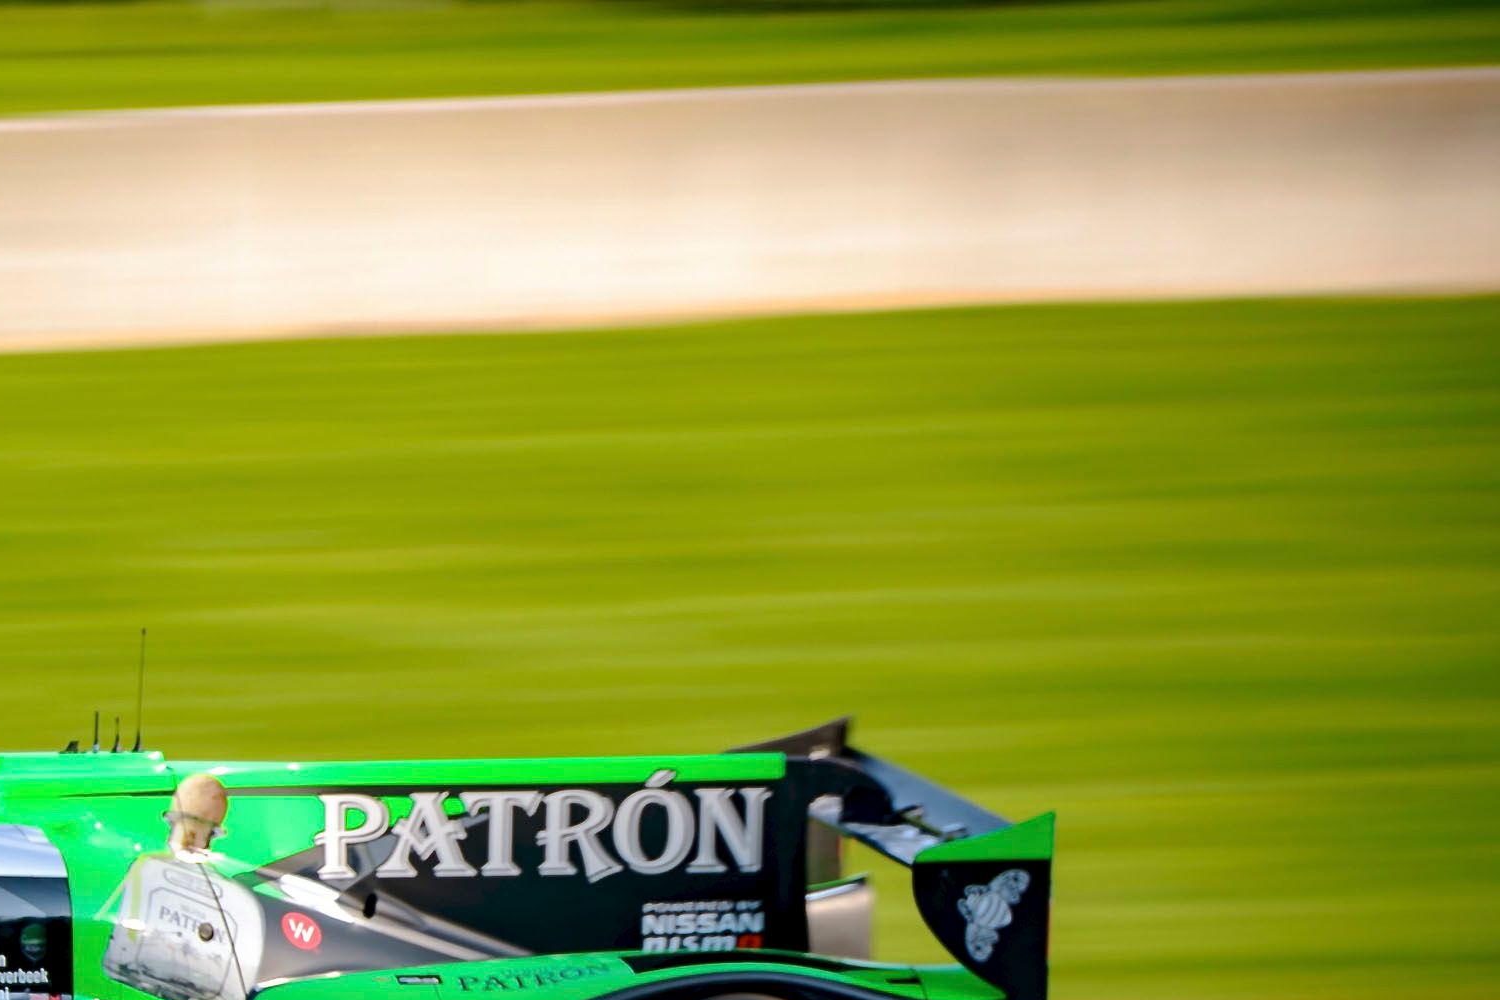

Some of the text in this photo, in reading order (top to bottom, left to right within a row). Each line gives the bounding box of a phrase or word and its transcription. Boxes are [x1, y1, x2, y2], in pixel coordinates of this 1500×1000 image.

[312, 769, 773, 884] PATRÓN
[159, 905, 227, 944] PATN
[641, 911, 766, 936] NISSAN
